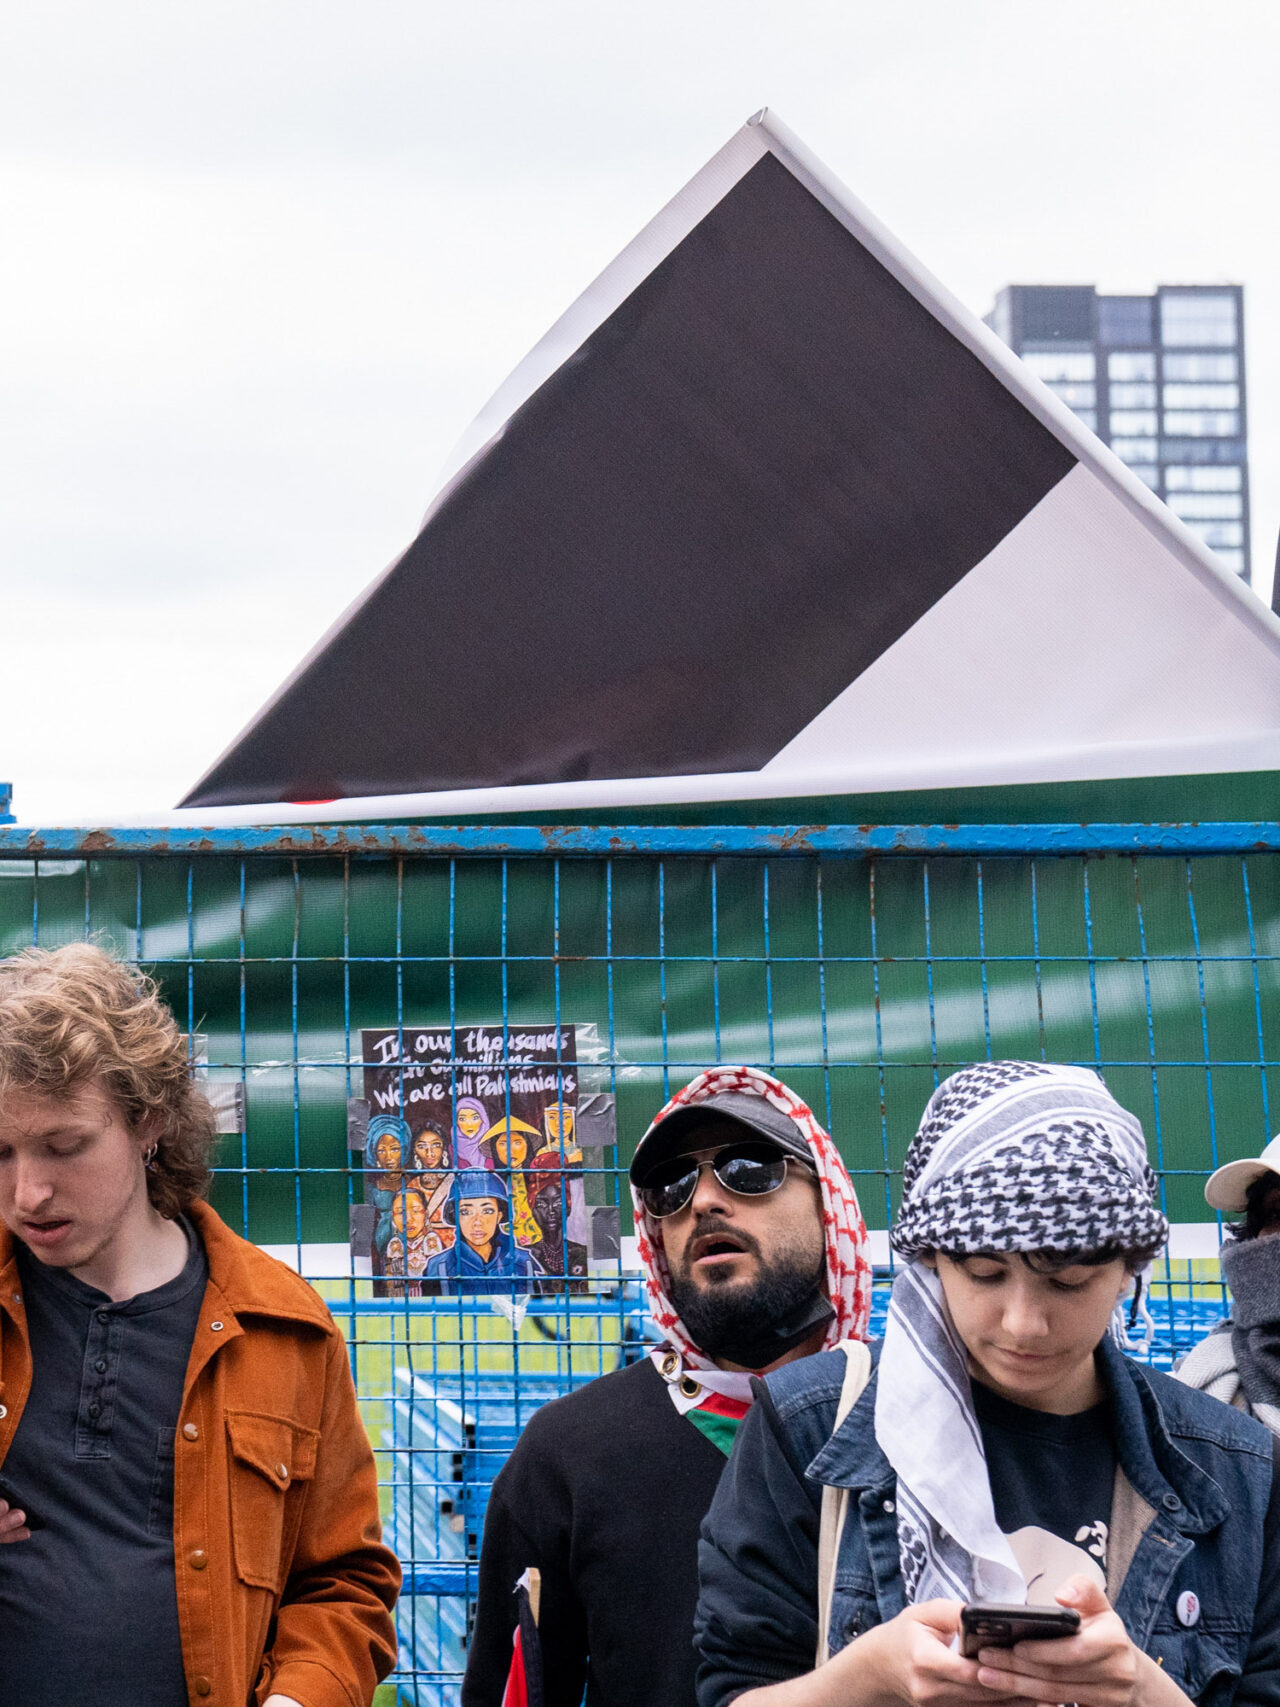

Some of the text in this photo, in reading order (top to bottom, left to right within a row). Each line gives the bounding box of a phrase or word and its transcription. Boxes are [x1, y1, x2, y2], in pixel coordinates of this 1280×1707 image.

[373, 1082, 409, 1110] We
[409, 1082, 446, 1103] are
[448, 1074, 473, 1096] all
